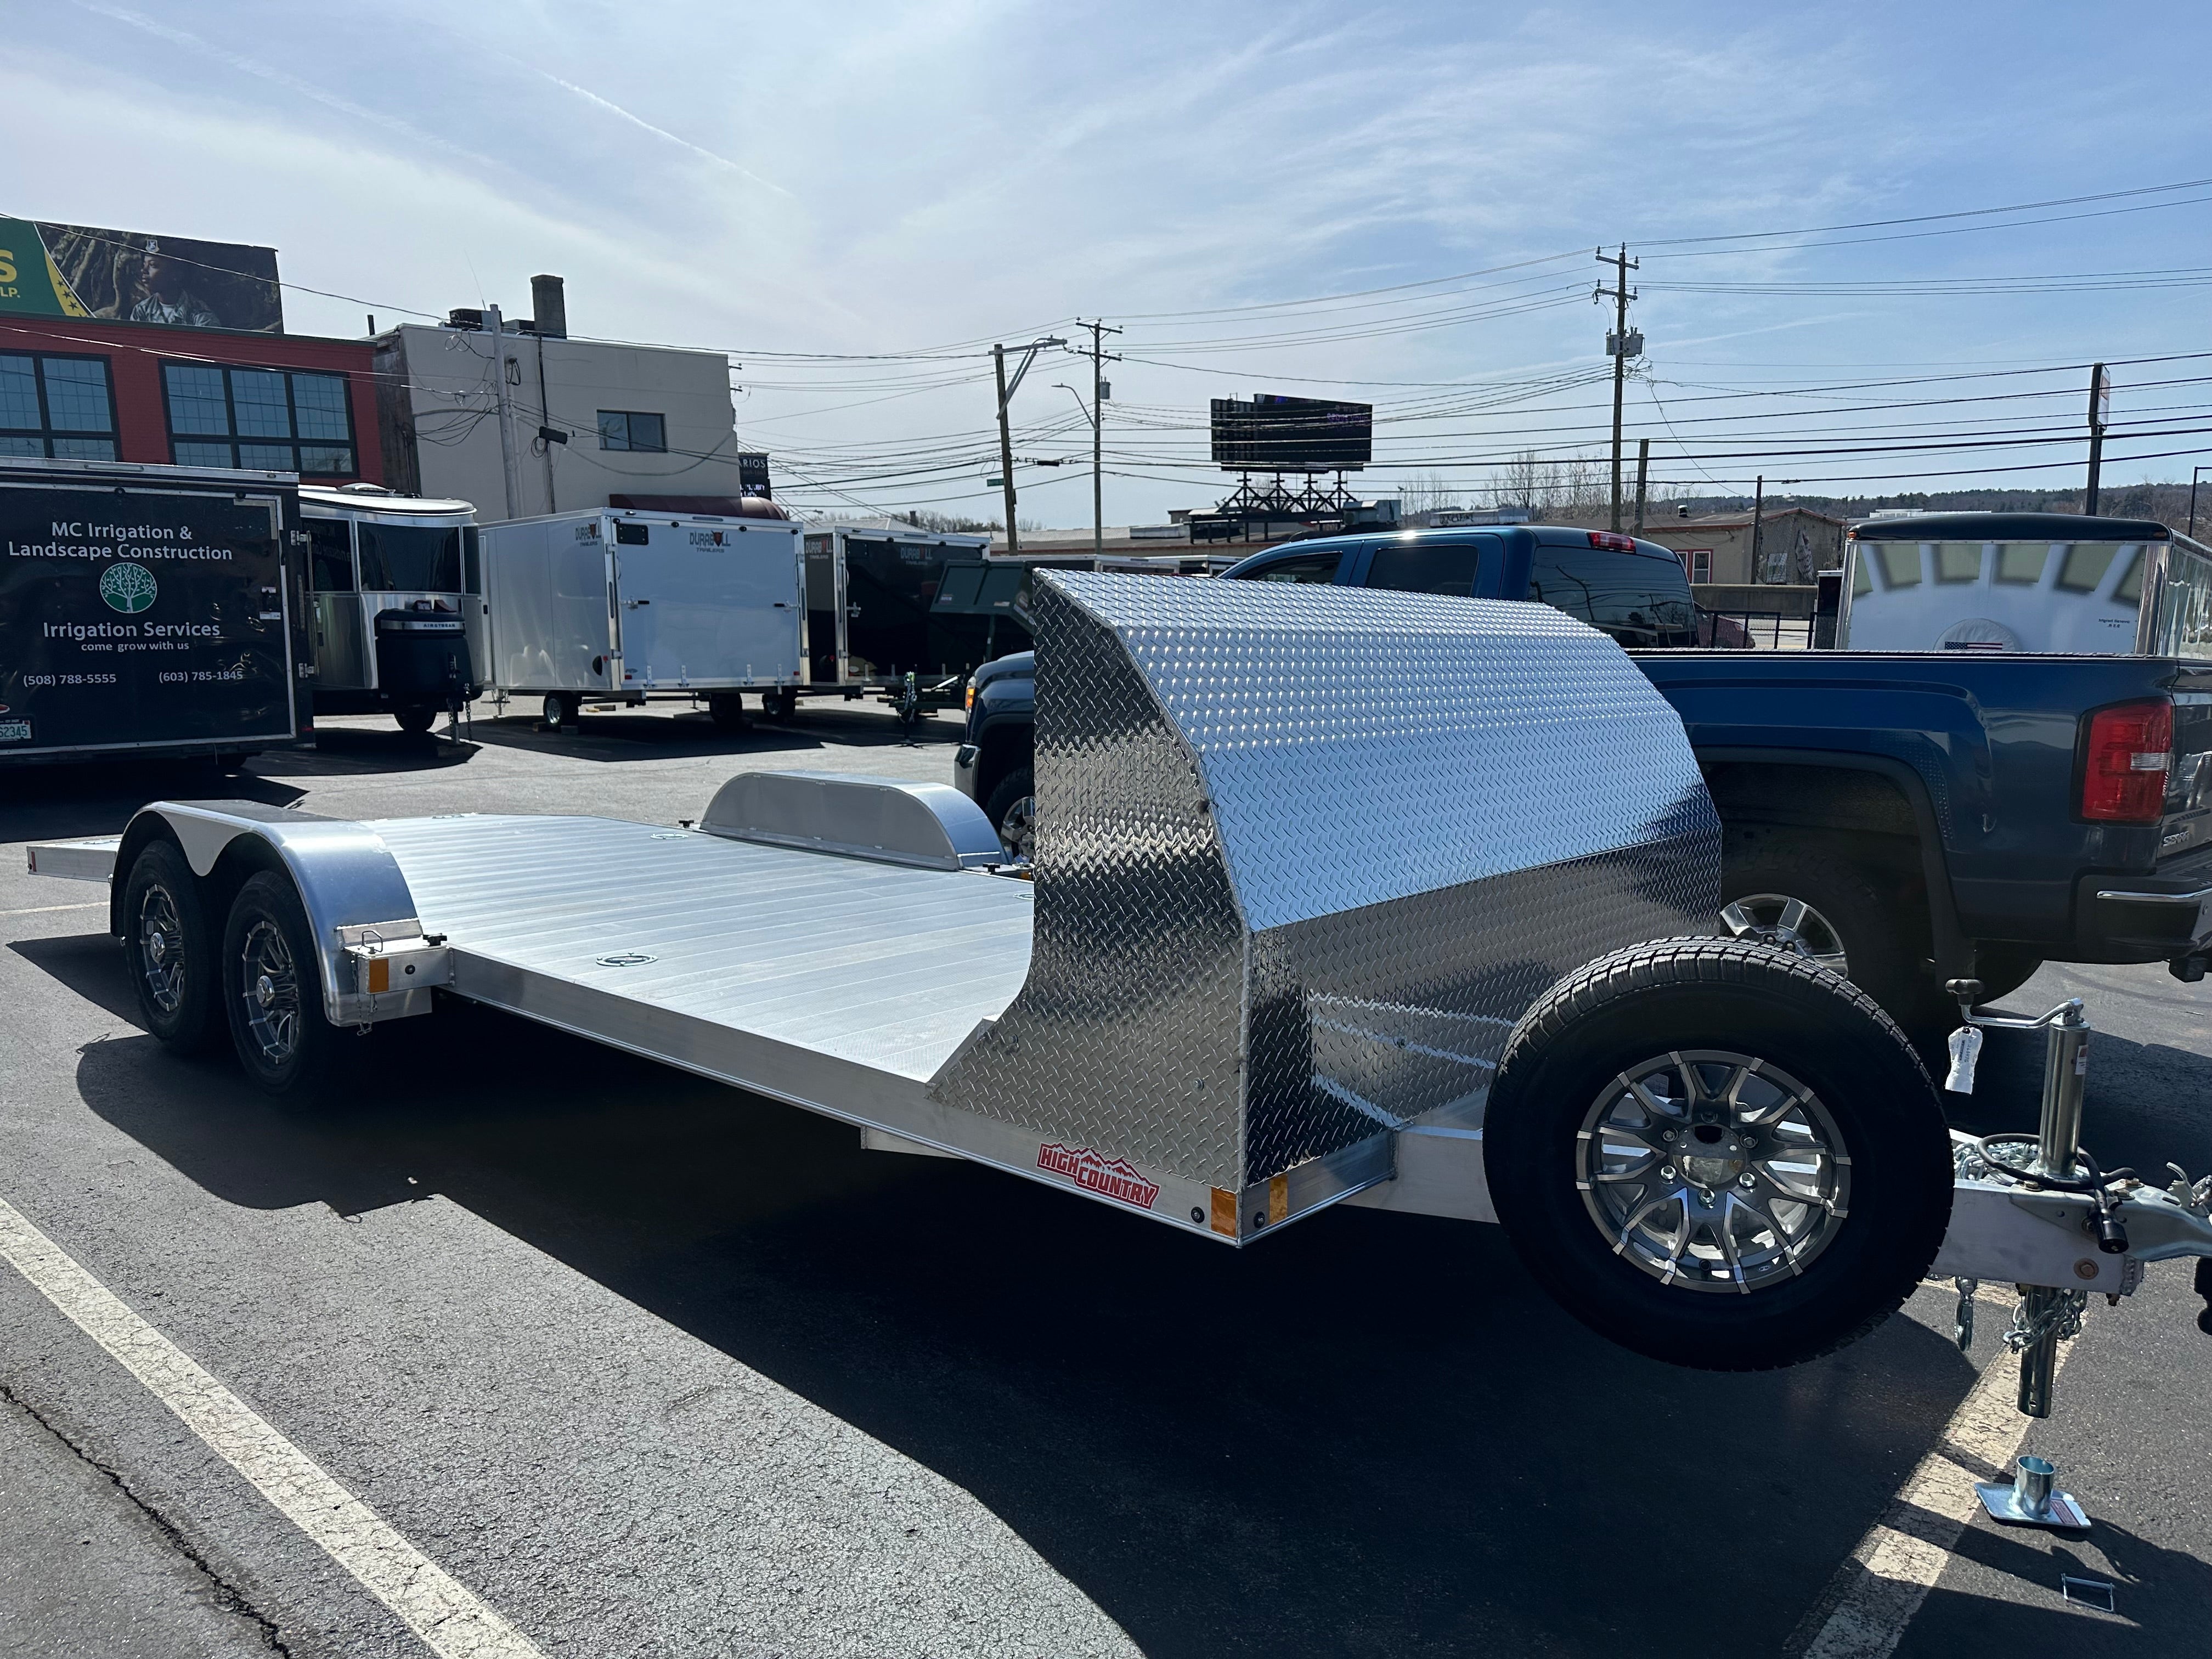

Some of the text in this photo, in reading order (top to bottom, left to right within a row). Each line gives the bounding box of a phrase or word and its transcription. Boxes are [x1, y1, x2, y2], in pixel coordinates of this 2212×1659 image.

[52, 522, 193, 541] MC Irrigation &
[690, 531, 731, 547] DURABLL
[8, 541, 233, 561] Landscape Construction
[43, 622, 220, 640] Irrigation Services
[81, 642, 112, 651] come
[117, 643, 147, 652] grow
[149, 641, 174, 651] with
[23, 674, 117, 687] (508) 788-5555
[159, 670, 243, 684] (603) 785-1845
[1041, 1147, 1080, 1175] HIGH
[1077, 1166, 1156, 1206] COUNTRY
